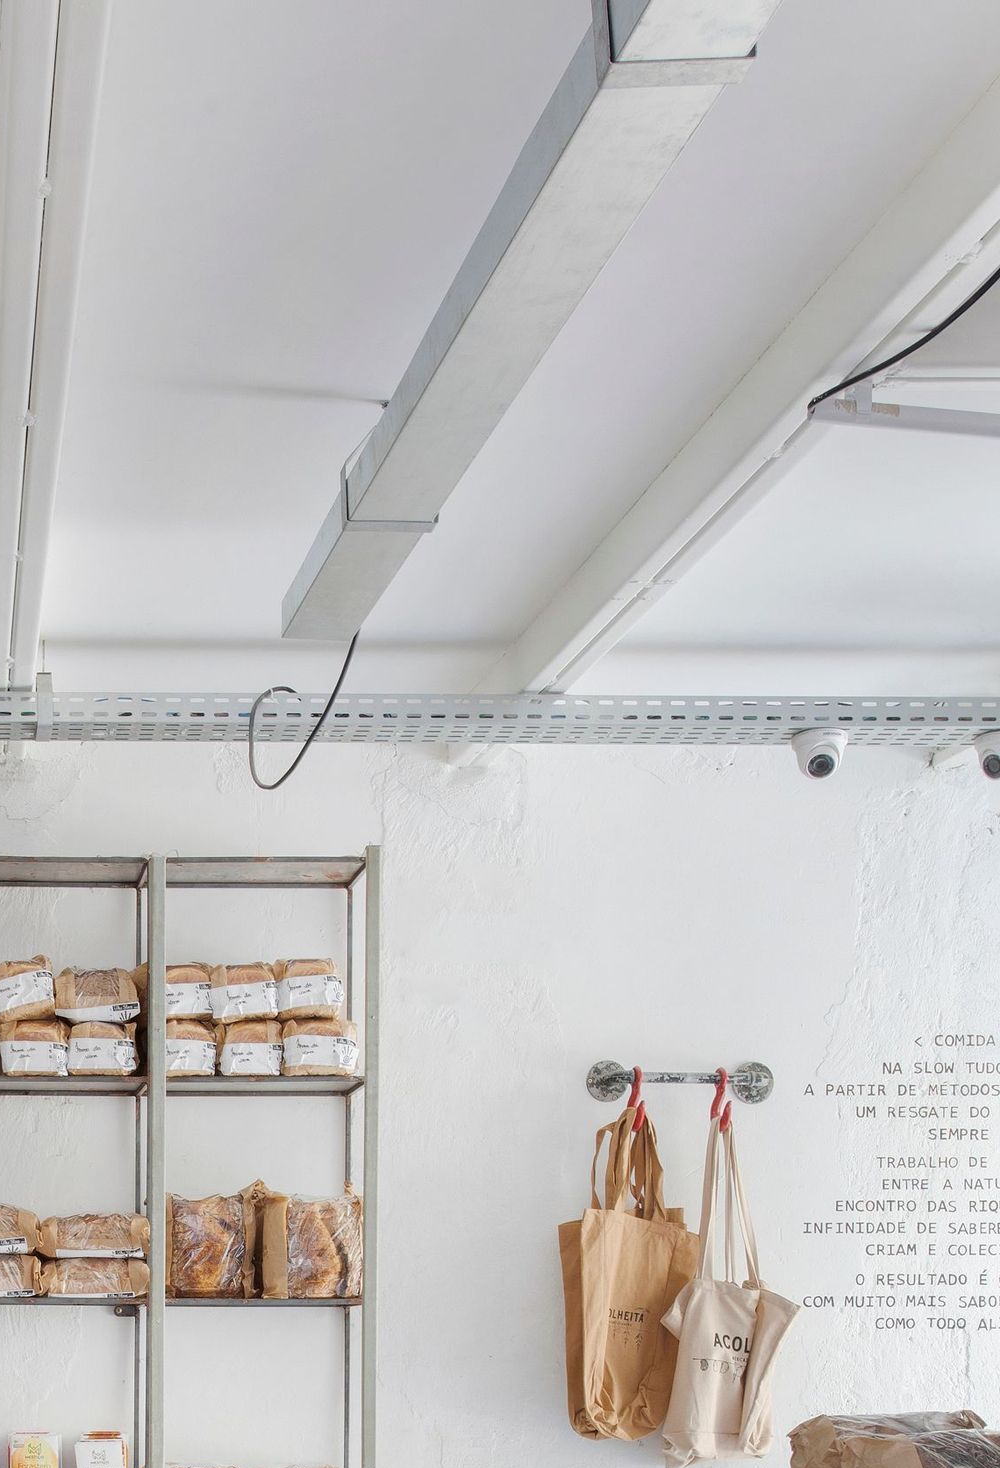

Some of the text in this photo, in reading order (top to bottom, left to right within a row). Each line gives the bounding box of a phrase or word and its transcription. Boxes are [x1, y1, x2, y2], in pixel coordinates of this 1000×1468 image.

[934, 1034, 996, 1047] COMIDA
[882, 1062, 903, 1075] NA
[913, 1062, 955, 1075] SLOW
[803, 1084, 815, 1097] A
[825, 1084, 887, 1097] PARTIR
[897, 1084, 917, 1097] DE
[855, 1106, 991, 1119] UM RESGATE DO
[927, 1128, 989, 1141] SEMPRE
[876, 1156, 988, 1169] TRABALHO DE
[882, 1178, 929, 1191] ENTRE
[942, 1178, 953, 1191] A
[835, 1200, 1000, 1213] ENCONTRO DAS RIQ
[802, 1222, 906, 1235] INFINIDADE
[916, 1222, 937, 1235] DE
[865, 1244, 1000, 1257] CRIAM E COLEC
[855, 1273, 865, 1286] O
[876, 1273, 968, 1287] RESULTADO
[979, 1269, 988, 1286] É
[802, 1296, 1000, 1308] COM MUITO MAIS SABO
[874, 1318, 916, 1330] COMO
[926, 1318, 967, 1330] TODO
